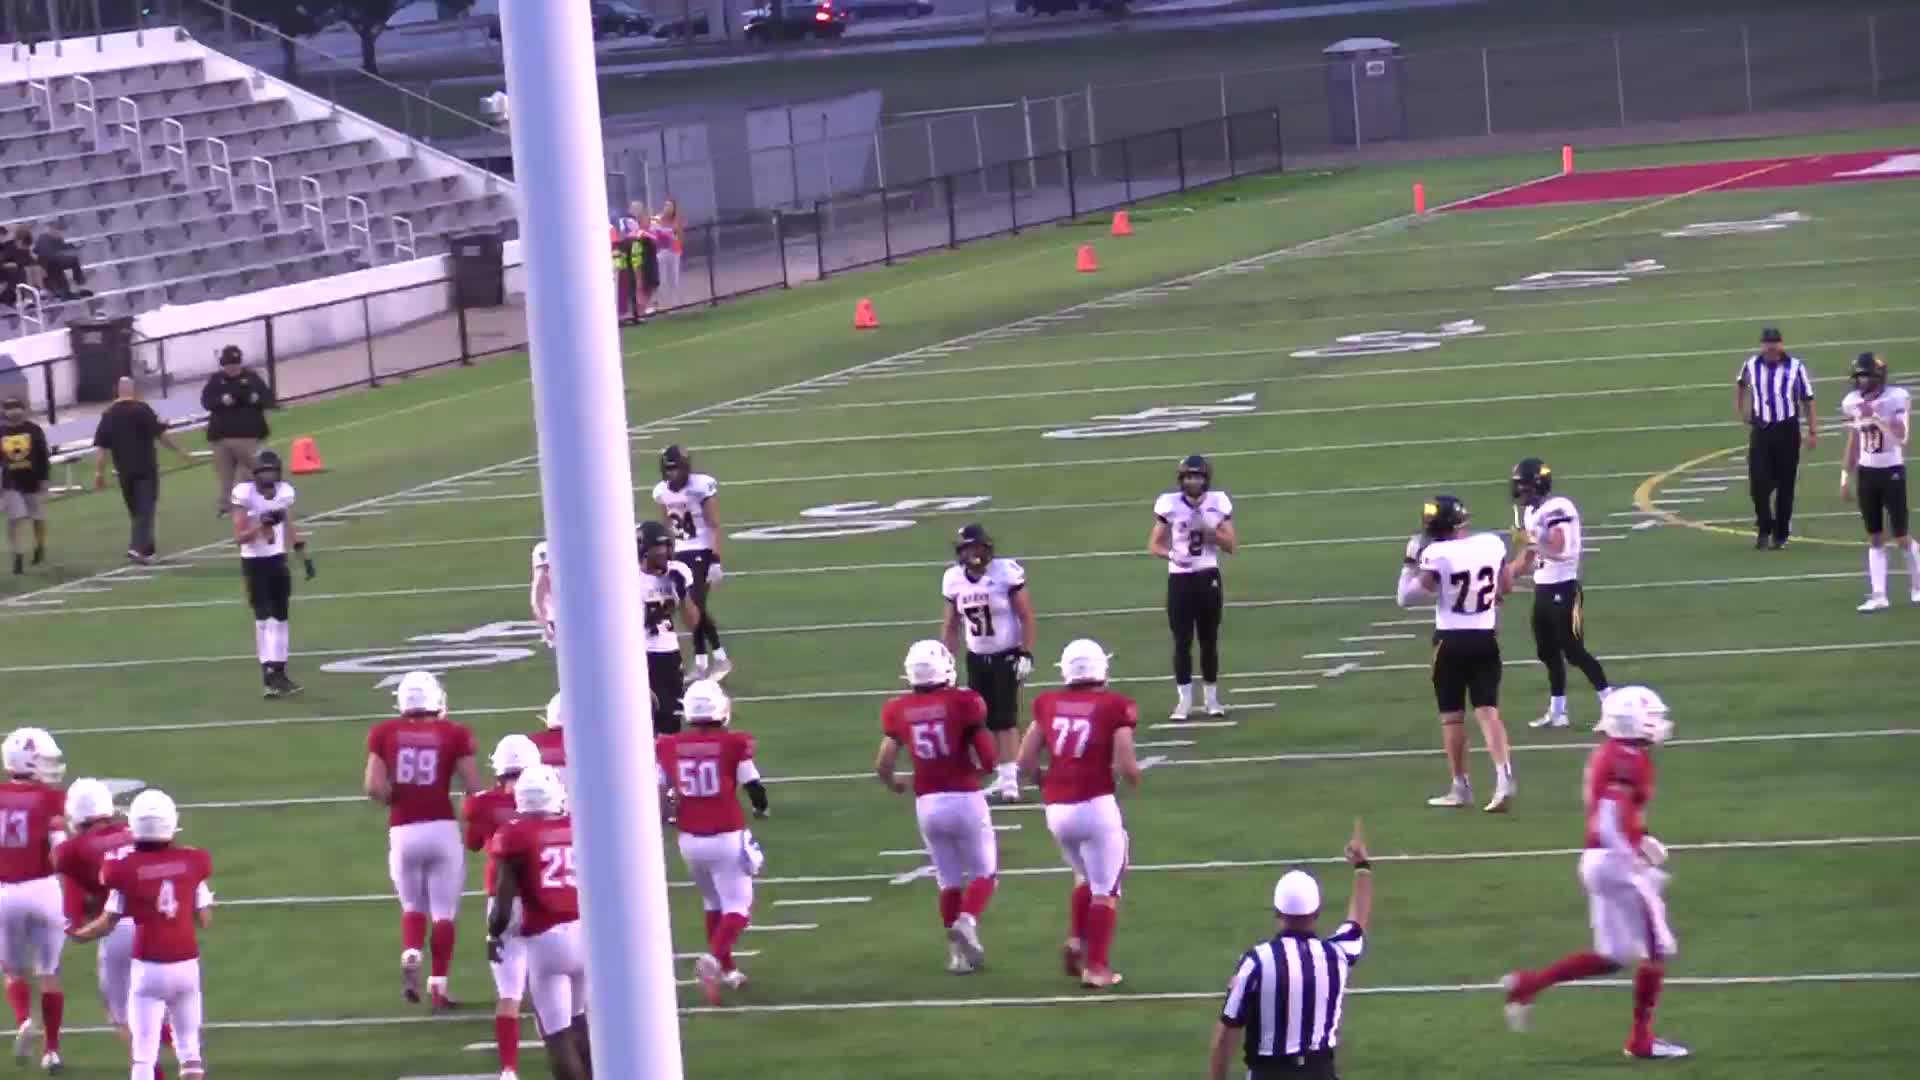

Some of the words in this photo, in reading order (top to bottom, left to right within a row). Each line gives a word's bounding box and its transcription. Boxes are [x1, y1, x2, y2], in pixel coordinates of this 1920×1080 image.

[728, 496, 992, 540] 50
[1451, 566, 1495, 614] 72
[964, 604, 996, 637] 51
[911, 722, 950, 760] 51
[1052, 716, 1091, 758] 77
[397, 747, 438, 786] 69
[677, 759, 720, 798] 50
[157, 879, 179, 919] 4
